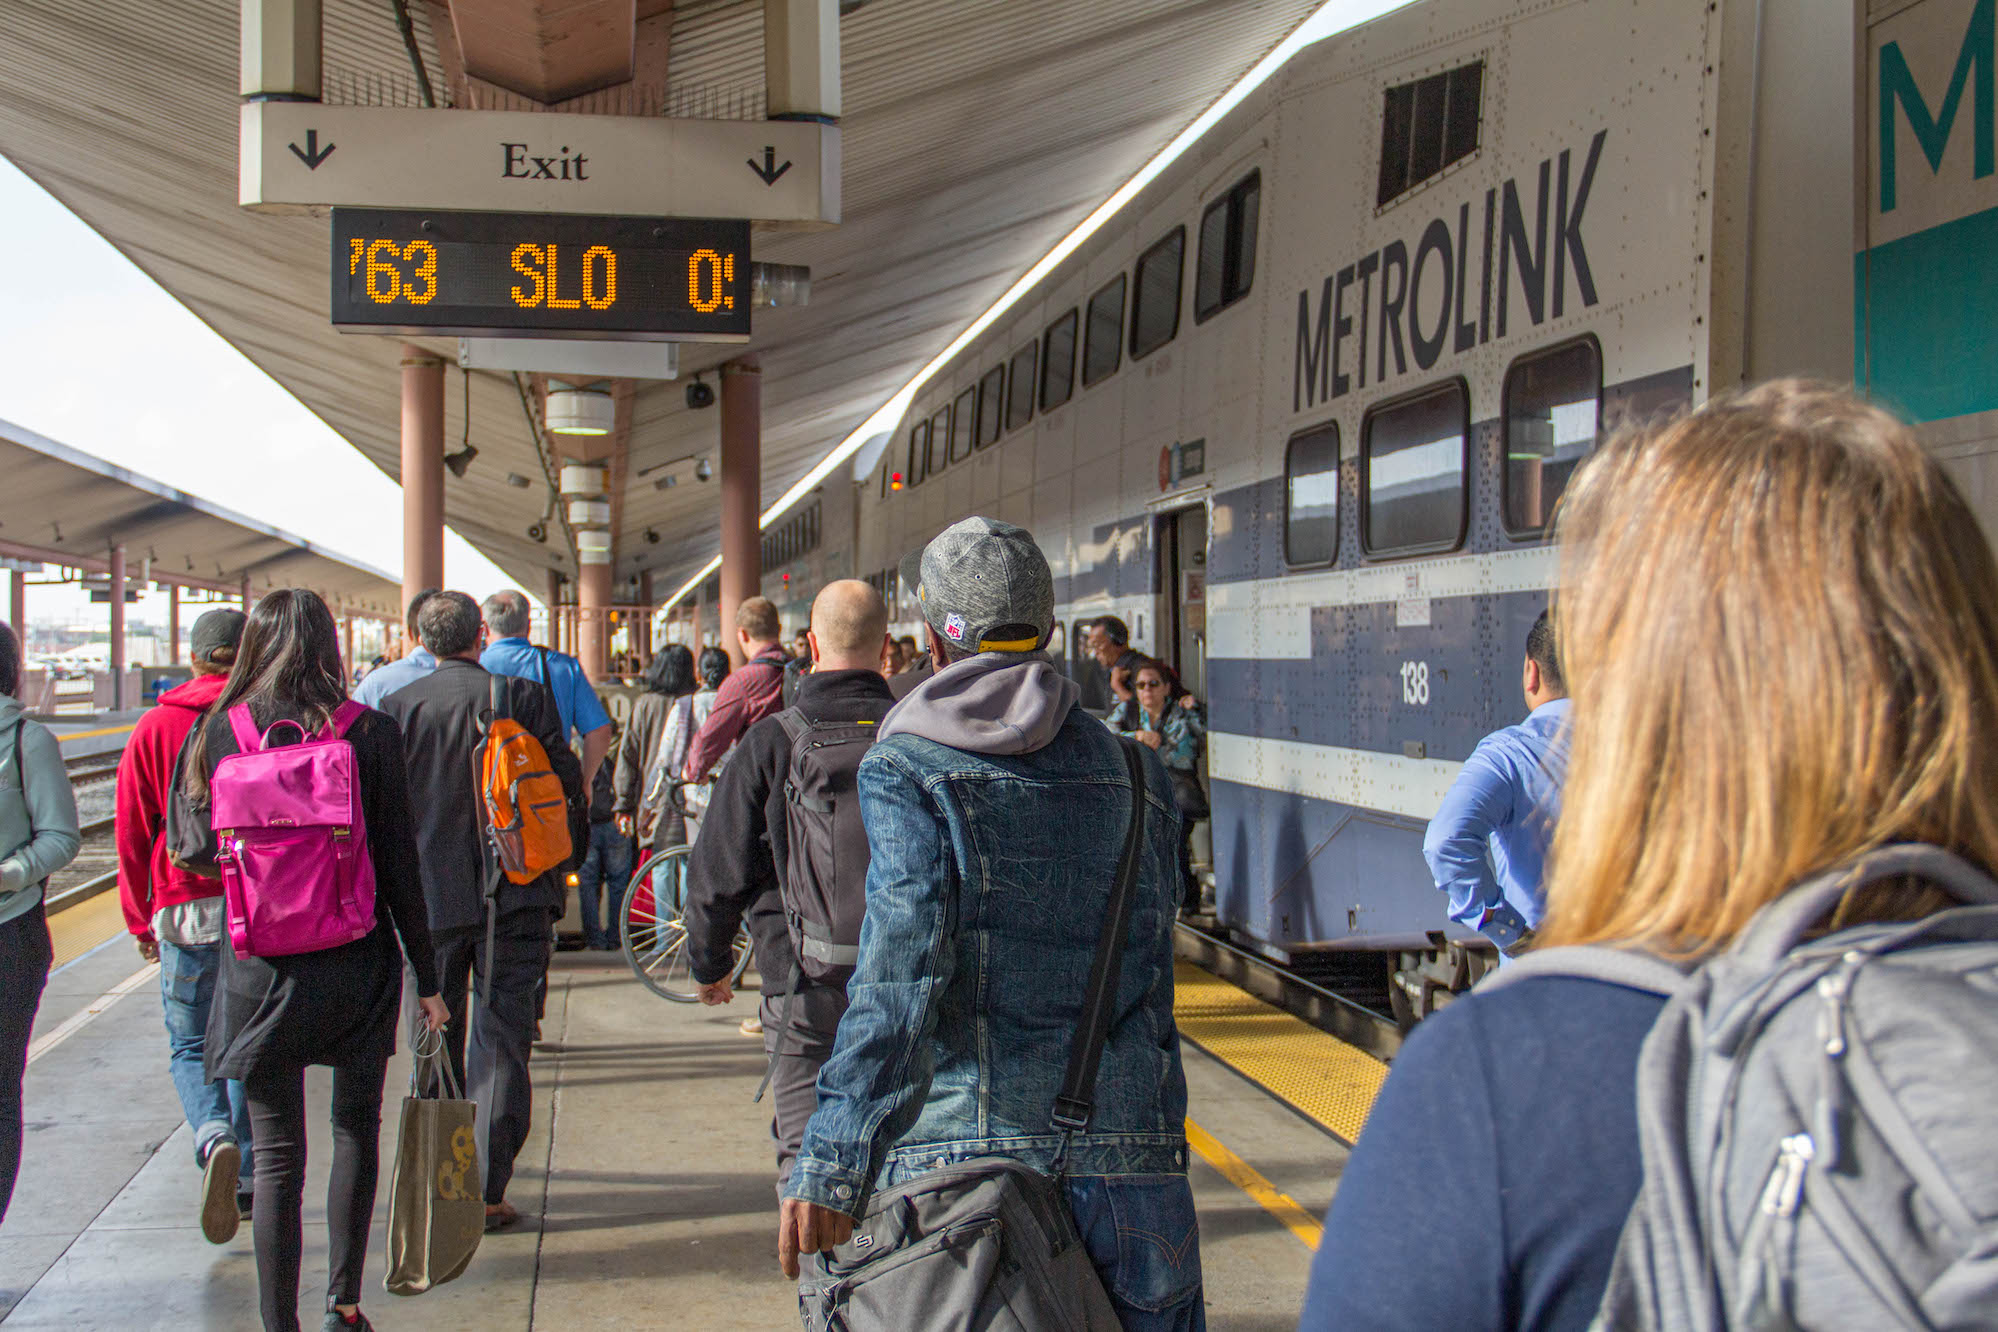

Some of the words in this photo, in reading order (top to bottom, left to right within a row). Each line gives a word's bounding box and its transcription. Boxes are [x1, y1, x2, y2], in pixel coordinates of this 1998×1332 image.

[501, 142, 589, 181] Exit
[510, 243, 617, 310] SLO
[688, 248, 734, 313] 0
[1294, 128, 1608, 413] METROLINK
[947, 623, 961, 638] NFL
[1400, 660, 1430, 705] 138
